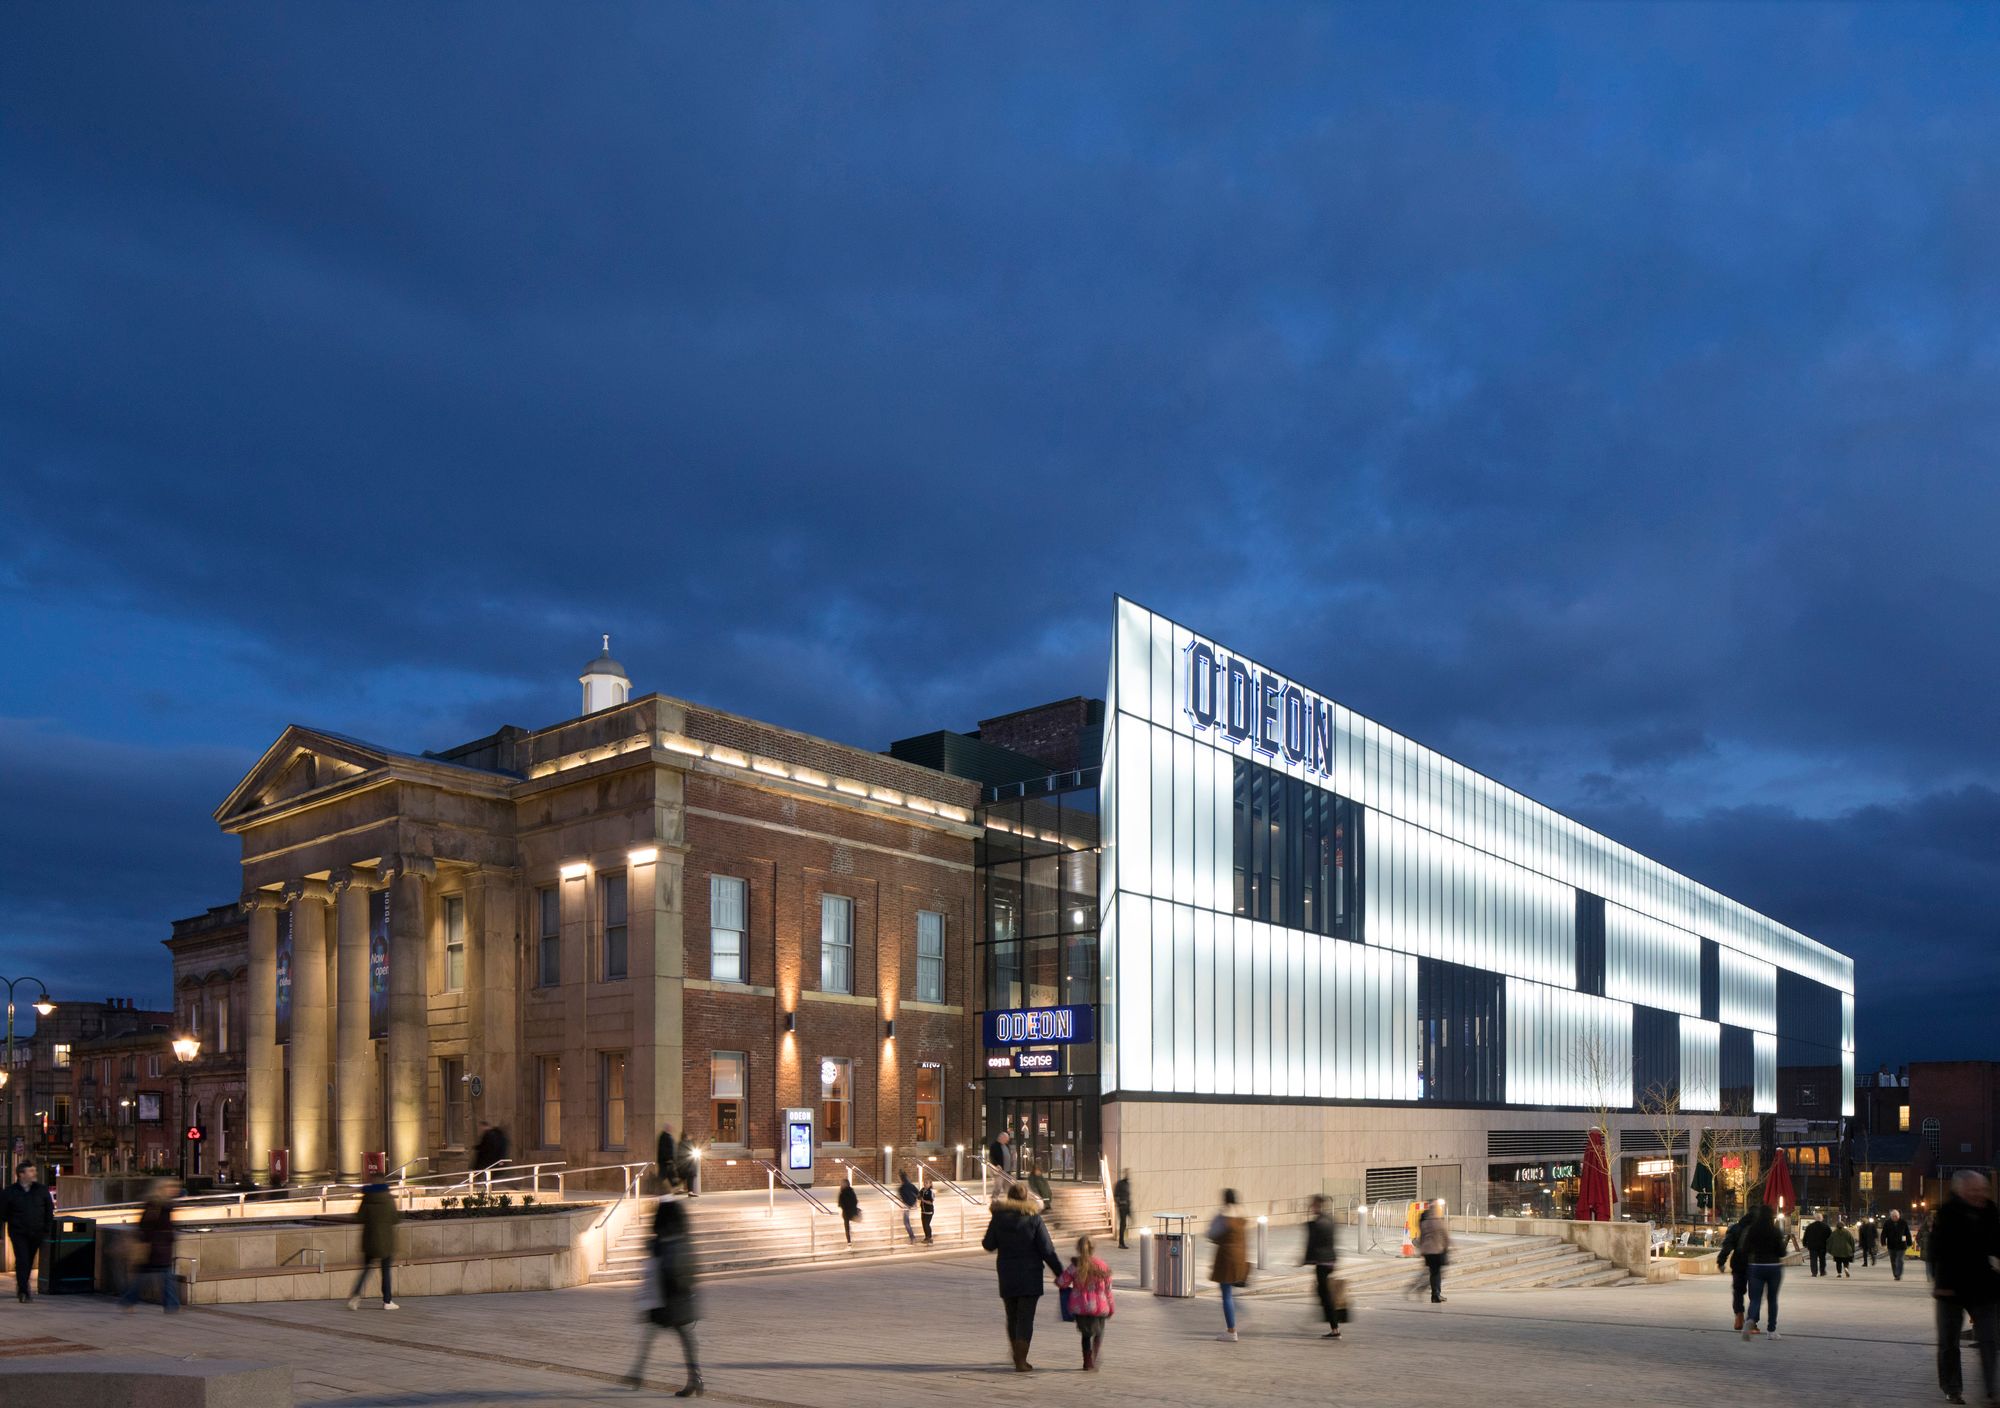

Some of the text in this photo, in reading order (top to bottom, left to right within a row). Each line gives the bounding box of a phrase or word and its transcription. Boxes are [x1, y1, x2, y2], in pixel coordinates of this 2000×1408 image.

[1183, 641, 1333, 779] ODEON
[997, 1010, 1072, 1040] ODEON
[988, 1058, 1011, 1067] COSTA
[1020, 1054, 1052, 1067] isense
[790, 1111, 811, 1120] ODEON
